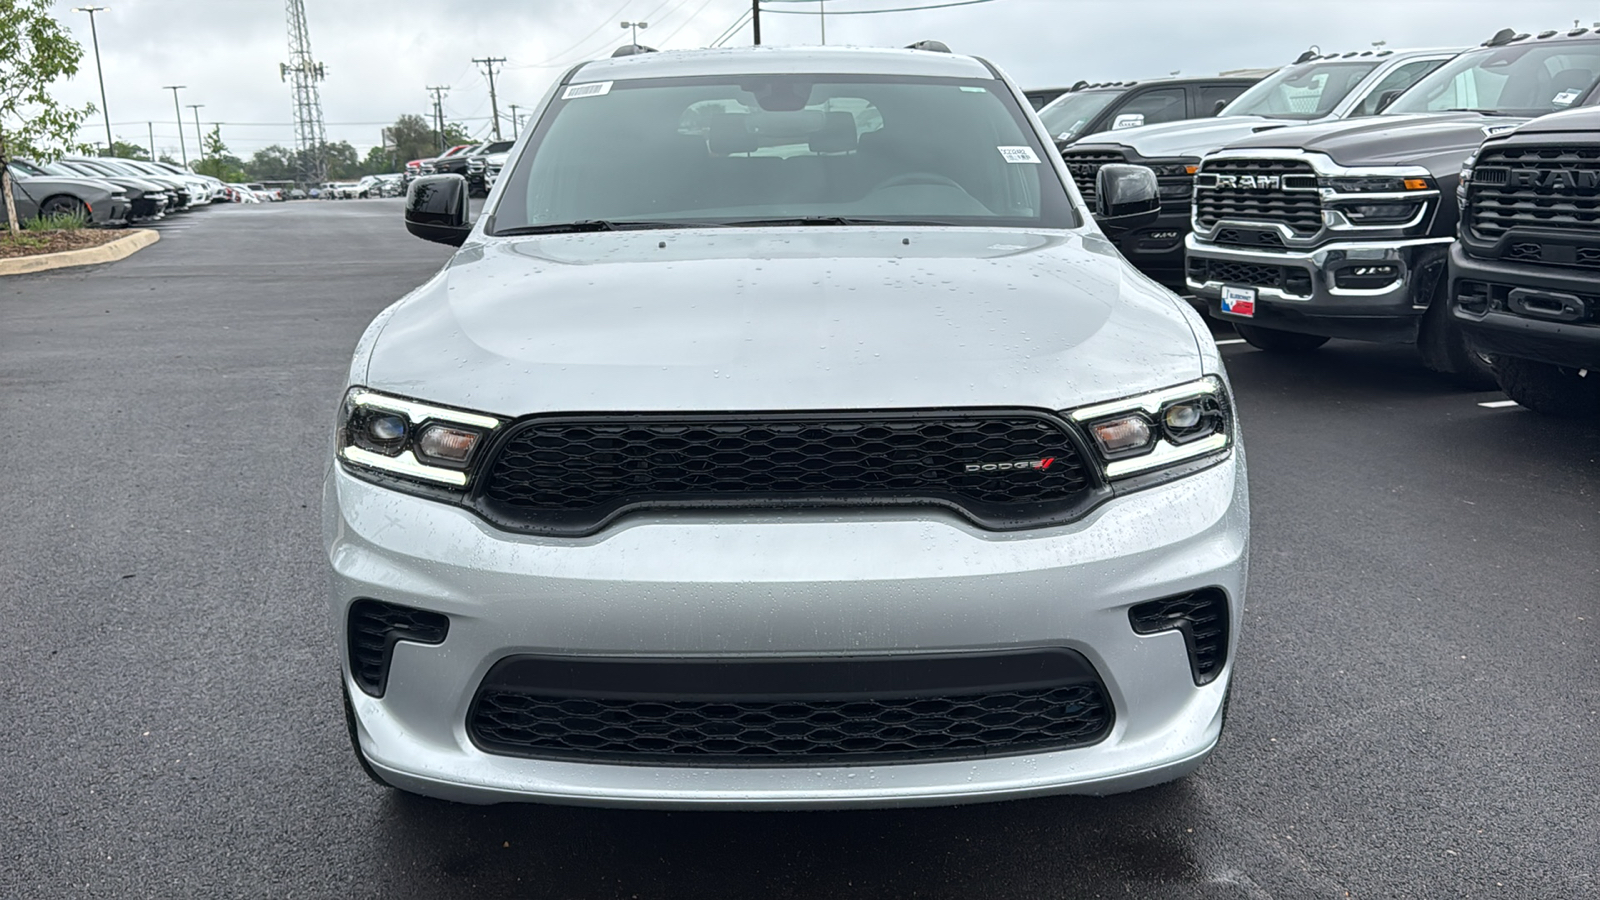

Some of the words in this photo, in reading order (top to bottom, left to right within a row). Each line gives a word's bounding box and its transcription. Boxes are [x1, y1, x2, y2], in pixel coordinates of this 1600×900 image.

[1216, 175, 1280, 190] RAM
[1510, 168, 1600, 189] RAM
[965, 461, 1042, 472] DODGE
